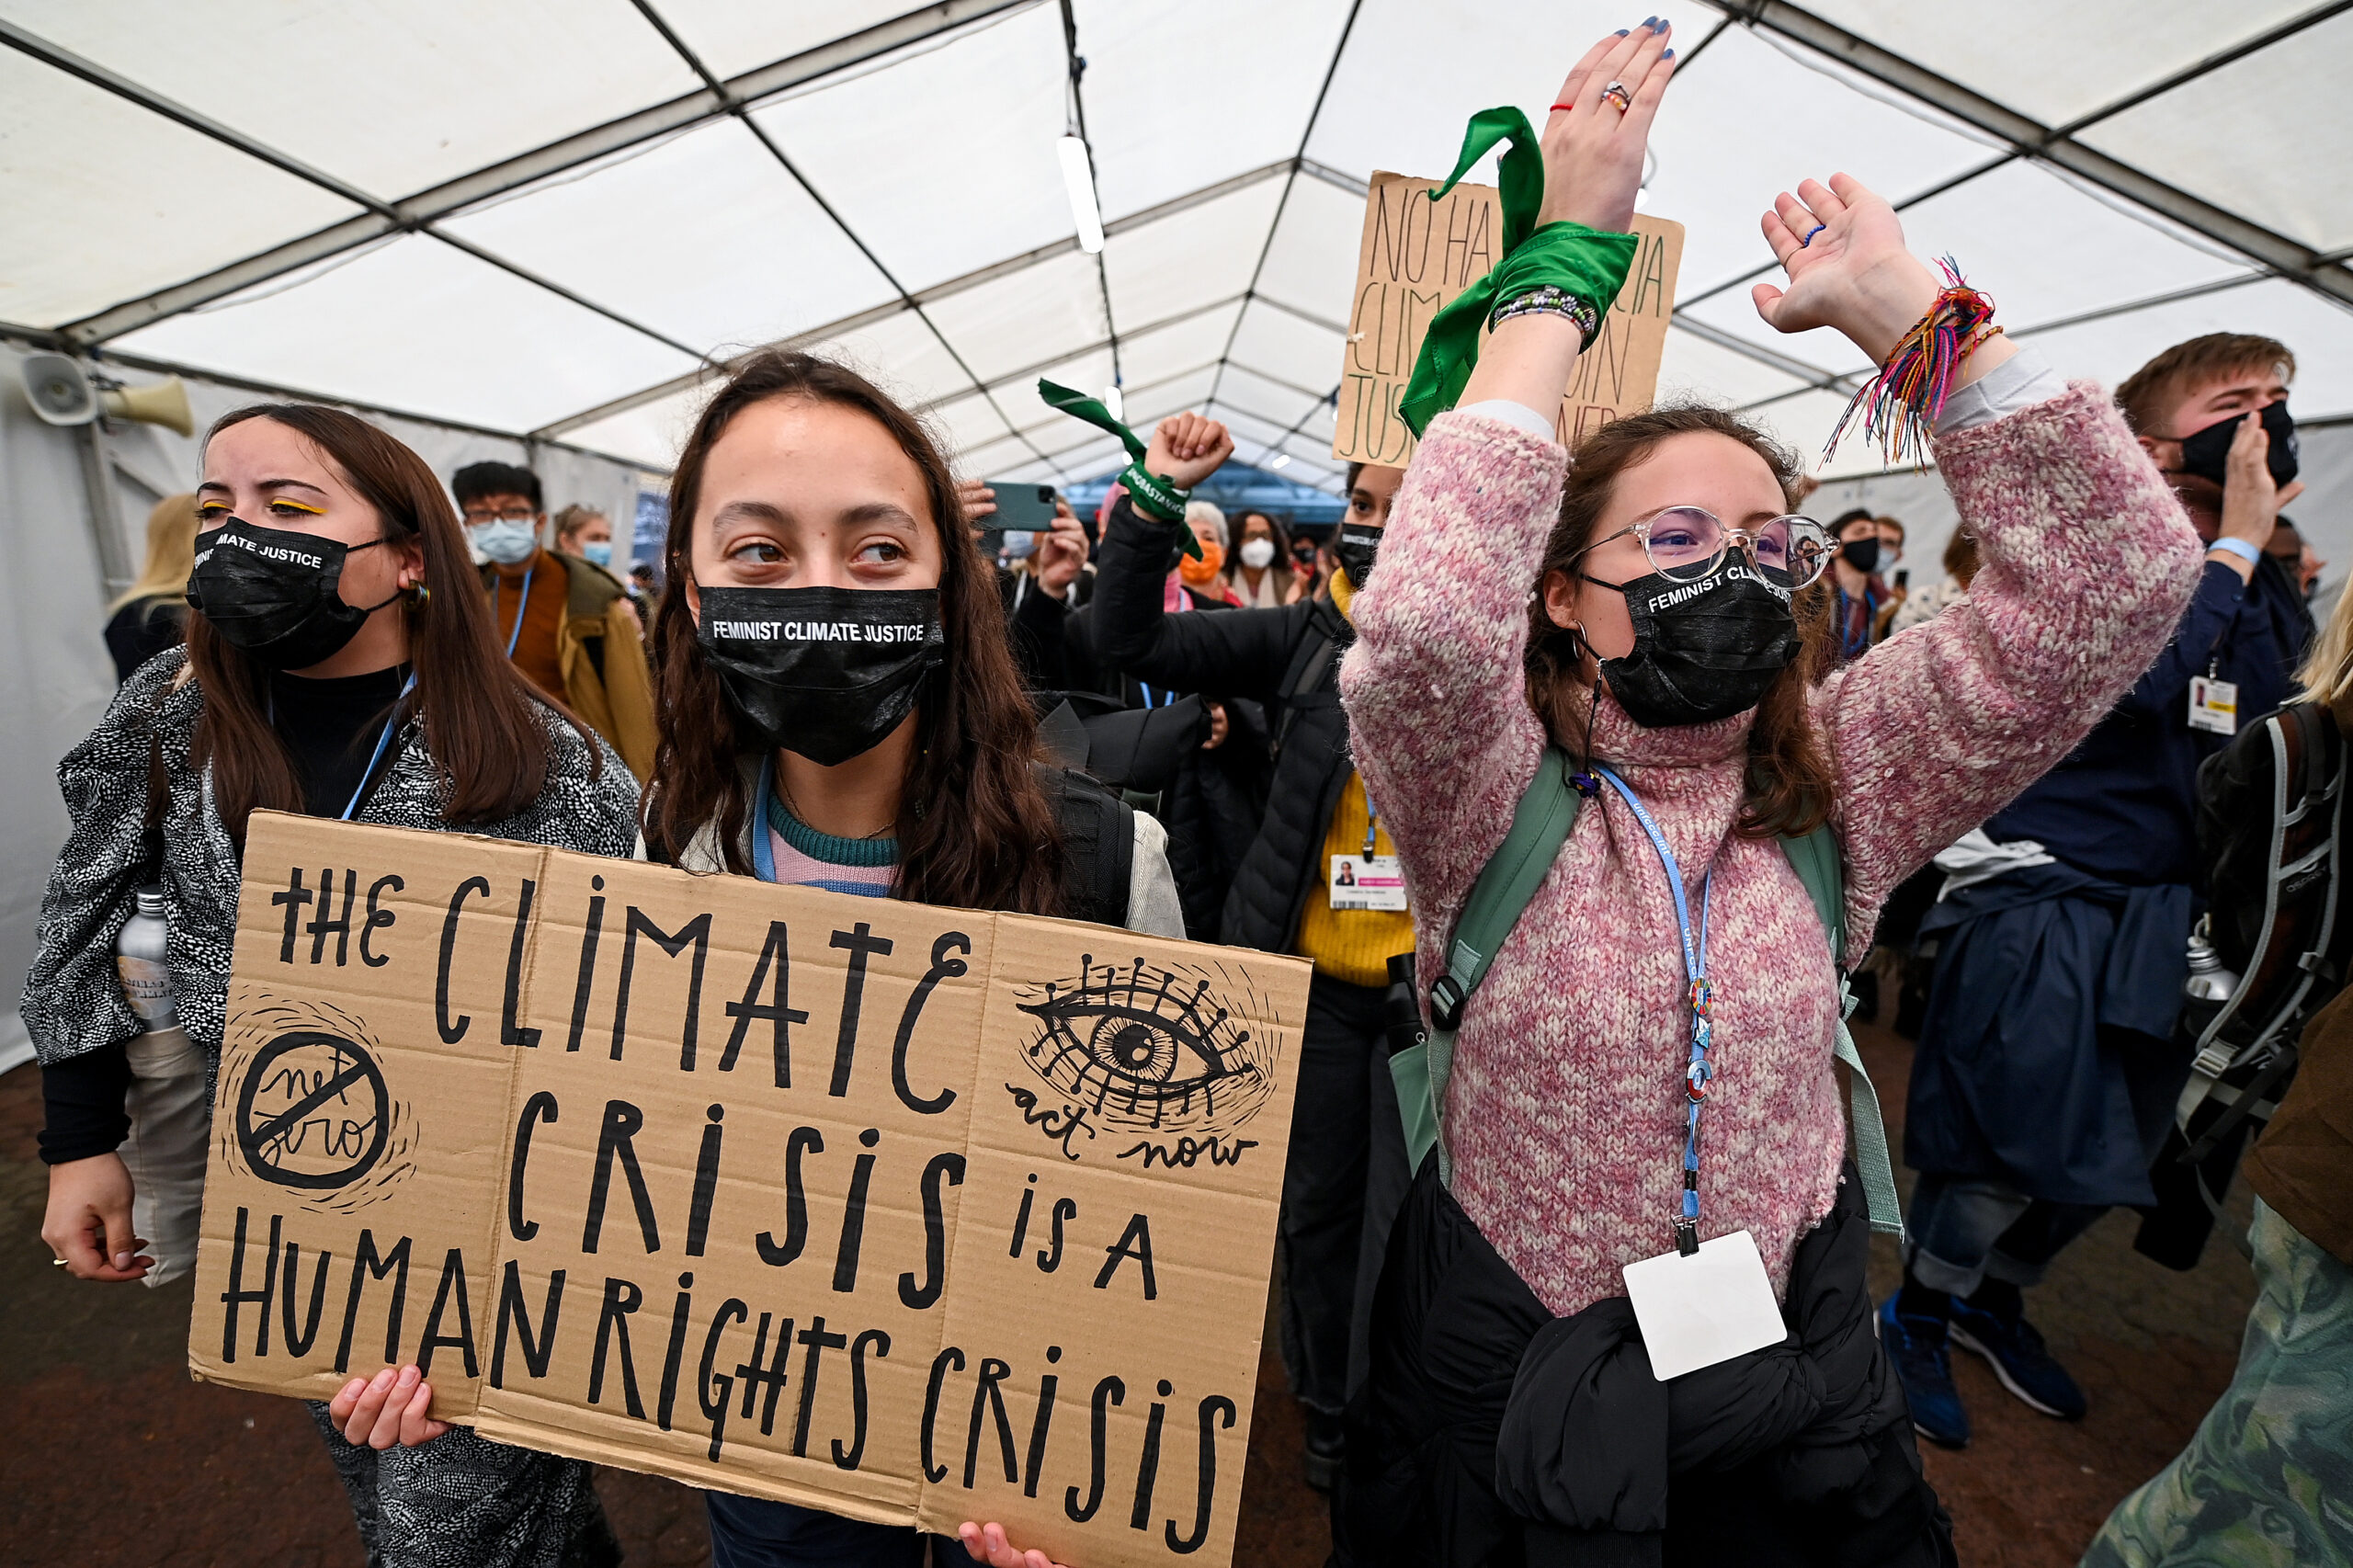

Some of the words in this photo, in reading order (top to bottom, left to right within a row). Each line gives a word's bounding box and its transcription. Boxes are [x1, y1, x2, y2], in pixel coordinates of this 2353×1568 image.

[1370, 185, 1432, 283] NO
[1442, 195, 1491, 288] HA
[1354, 281, 1441, 379] CLIM
[1338, 373, 1413, 463] JUS
[258, 546, 323, 569] JUSTICE
[1648, 572, 1722, 614] FEMINIST
[712, 620, 781, 641] FEMINIST
[783, 621, 862, 642] CLIMATE
[863, 624, 924, 642] JUSTICE
[271, 867, 405, 967] THE
[1684, 926, 1699, 981] UNFCC
[260, 1048, 351, 1106] net
[1005, 1083, 1096, 1161] act
[1116, 1135, 1259, 1169] now
[220, 1206, 568, 1392] HUMAN
[1094, 1213, 1157, 1301] A
